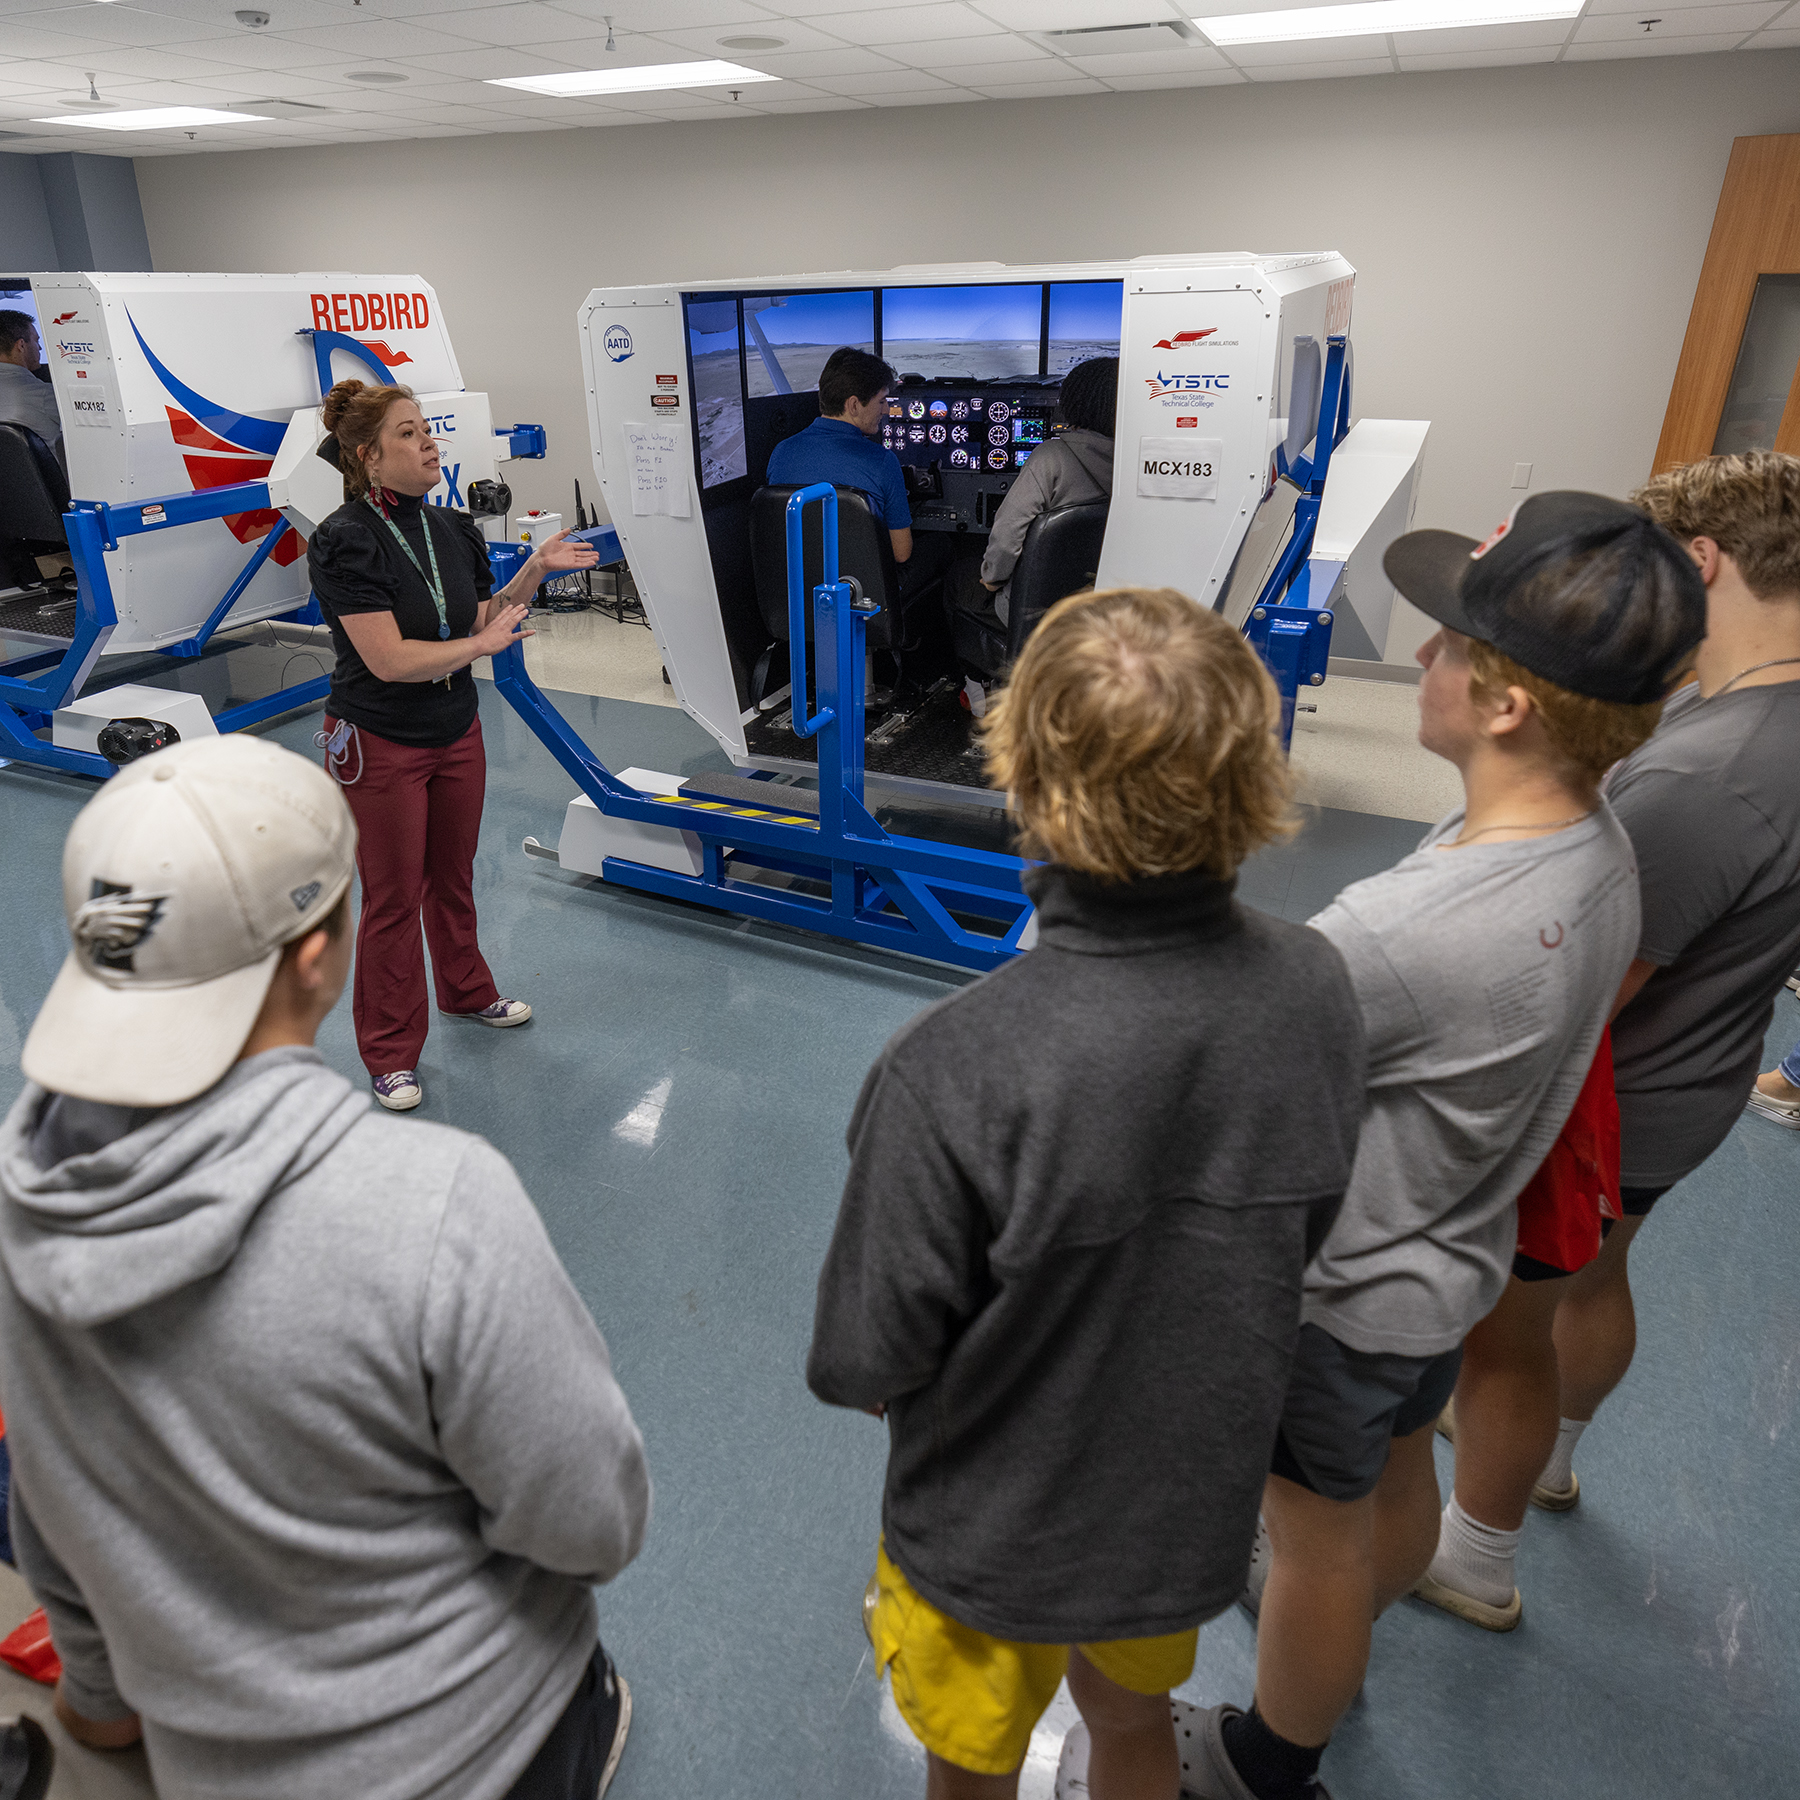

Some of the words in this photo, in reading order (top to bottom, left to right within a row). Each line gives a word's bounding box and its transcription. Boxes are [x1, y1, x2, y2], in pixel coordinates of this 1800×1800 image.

[310, 293, 430, 332] REDBIRD
[67, 342, 94, 352] TSTC
[607, 338, 630, 349] AATD
[1171, 374, 1230, 389] TSTC
[74, 401, 106, 412] MCX182
[1190, 400, 1214, 409] College
[1143, 460, 1212, 477] MCX183
